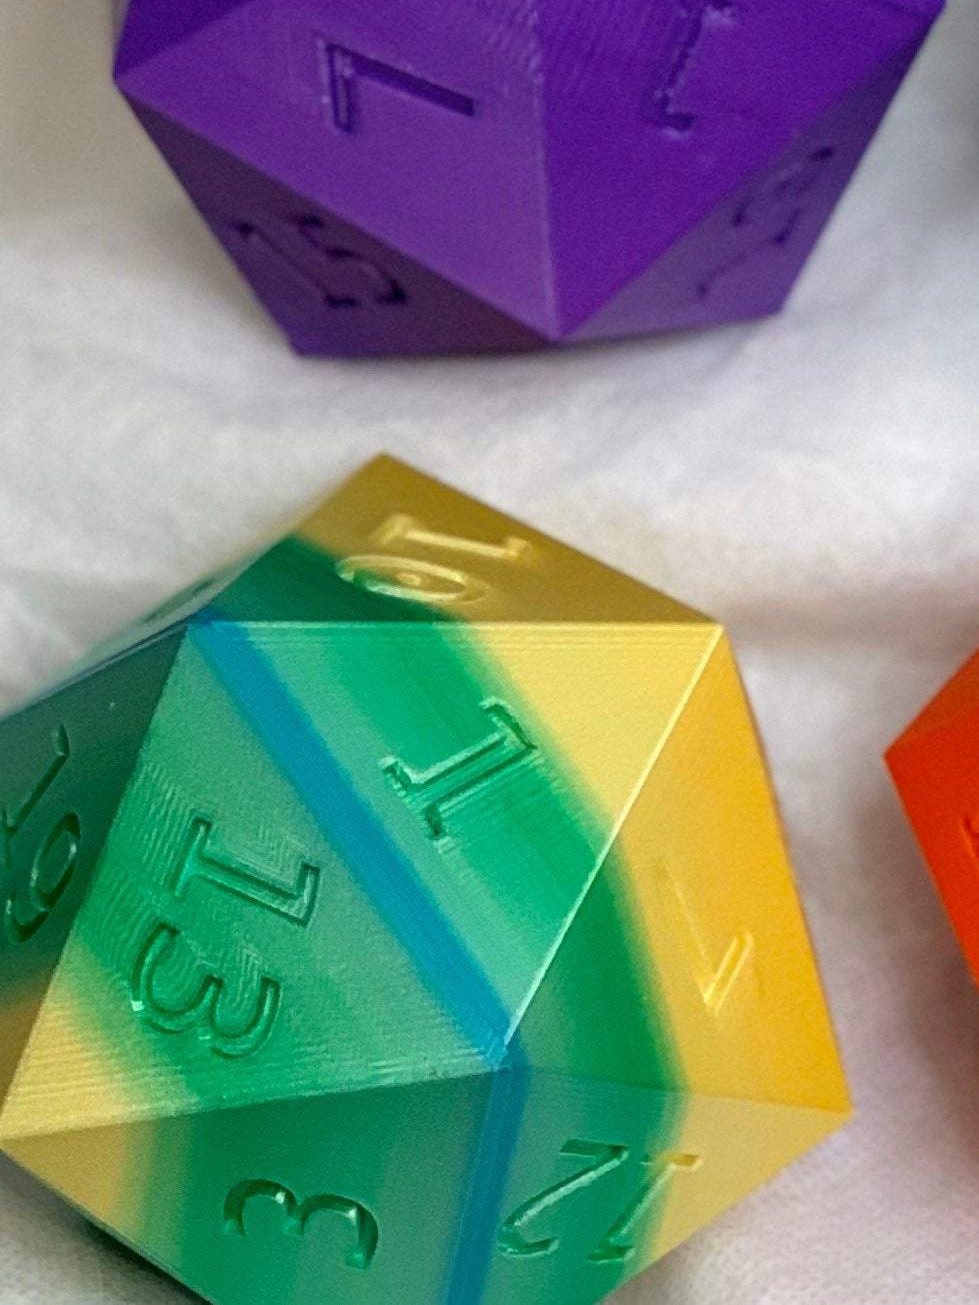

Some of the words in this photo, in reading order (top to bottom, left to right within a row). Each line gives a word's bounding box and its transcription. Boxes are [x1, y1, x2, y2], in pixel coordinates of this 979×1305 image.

[318, 38, 476, 136] 7
[335, 514, 535, 604] 10
[378, 694, 540, 844] 1
[131, 817, 321, 1060] 13
[660, 860, 757, 1018] 7
[223, 1176, 380, 1269] 3
[498, 1137, 702, 1265] 12
